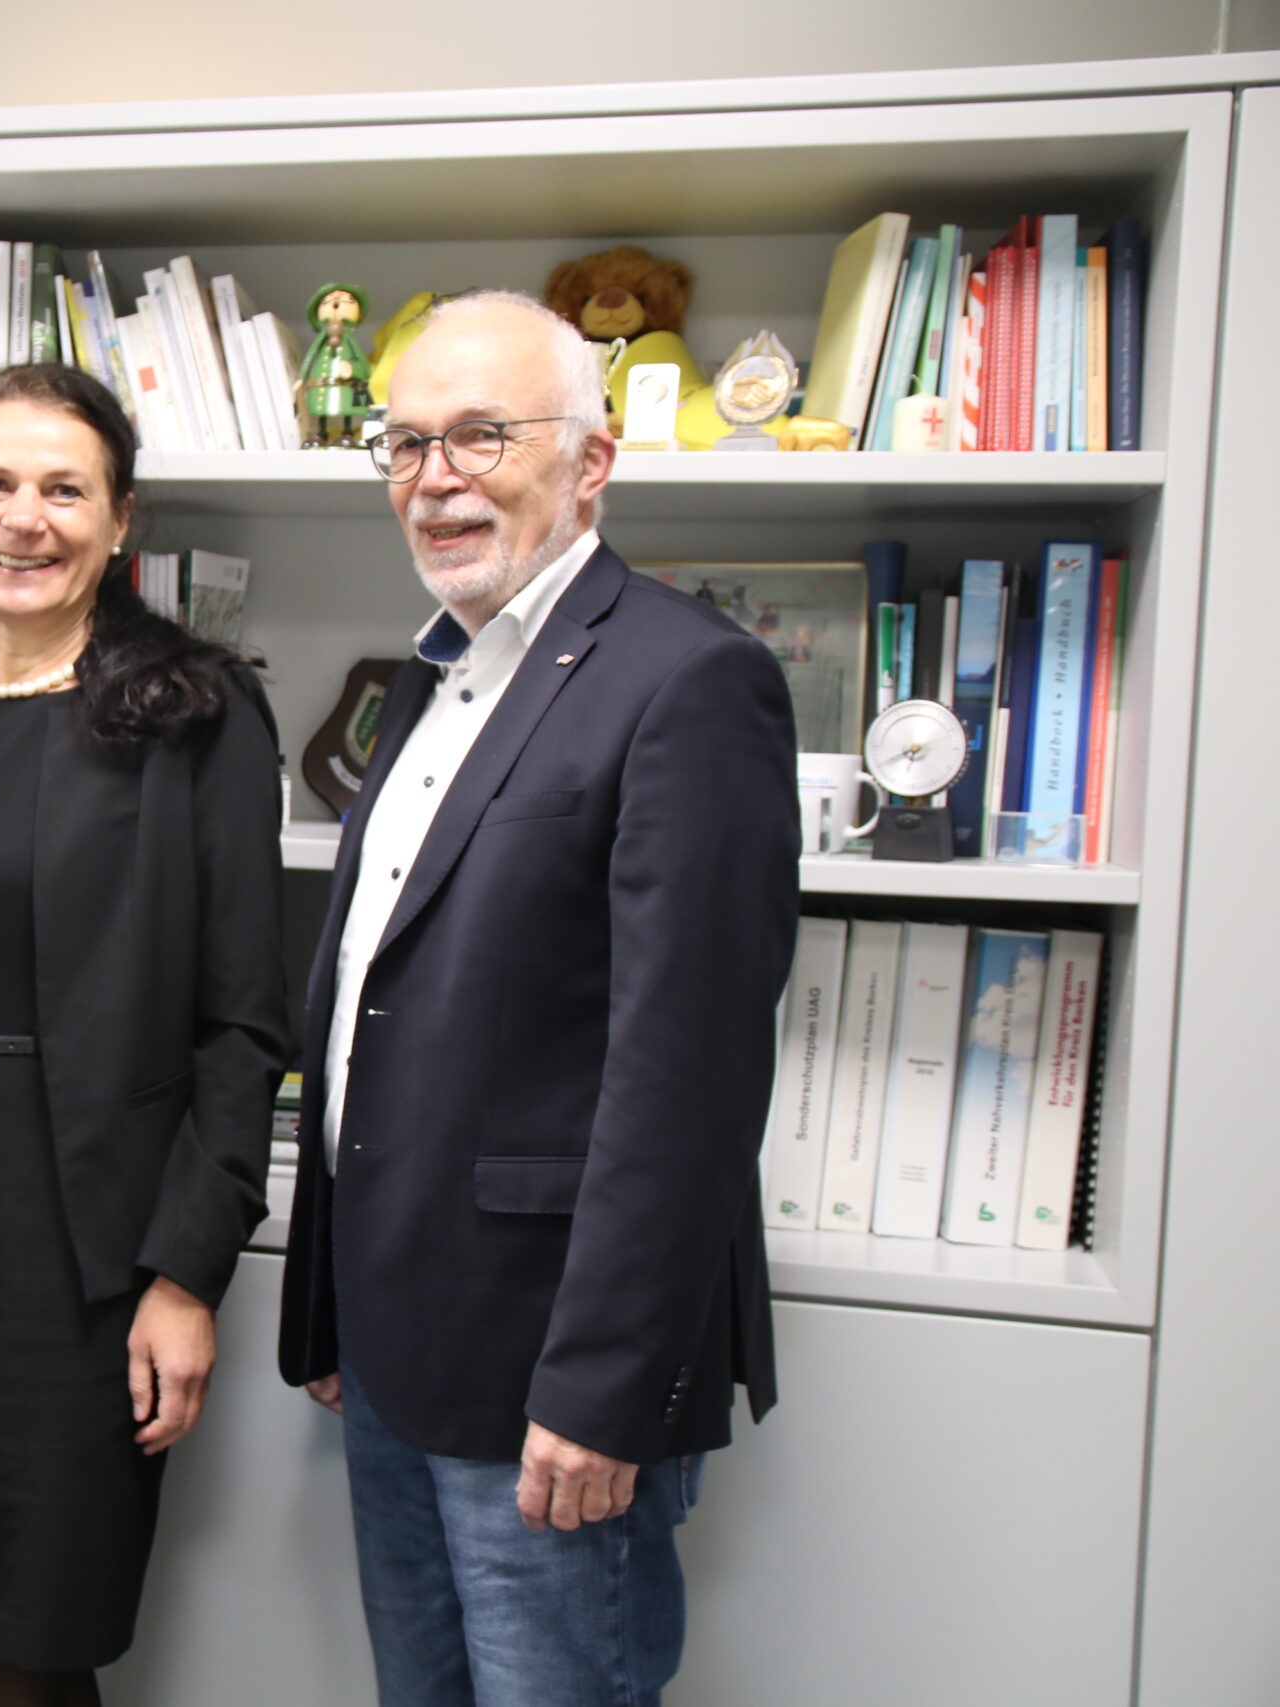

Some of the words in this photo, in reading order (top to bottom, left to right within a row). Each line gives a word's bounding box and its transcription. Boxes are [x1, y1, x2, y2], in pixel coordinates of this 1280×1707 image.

[1055, 598, 1072, 684] Handbuch
[867, 972, 879, 1006] Borken
[1072, 981, 1088, 1022] Borken
[863, 1007, 875, 1044] Kreises
[1001, 997, 1013, 1029] Kreis
[1048, 960, 1075, 1106] Entwicklungsprogramm
[1068, 1025, 1081, 1059] Kreis
[796, 1020, 820, 1141] Sonderschutzplan
[810, 987, 822, 1017] UAG
[991, 1031, 1011, 1133] Nahverkehrsplan
[1065, 1062, 1077, 1085] den
[1062, 1089, 1074, 1107] für
[985, 1134, 1000, 1180] Zweiter
